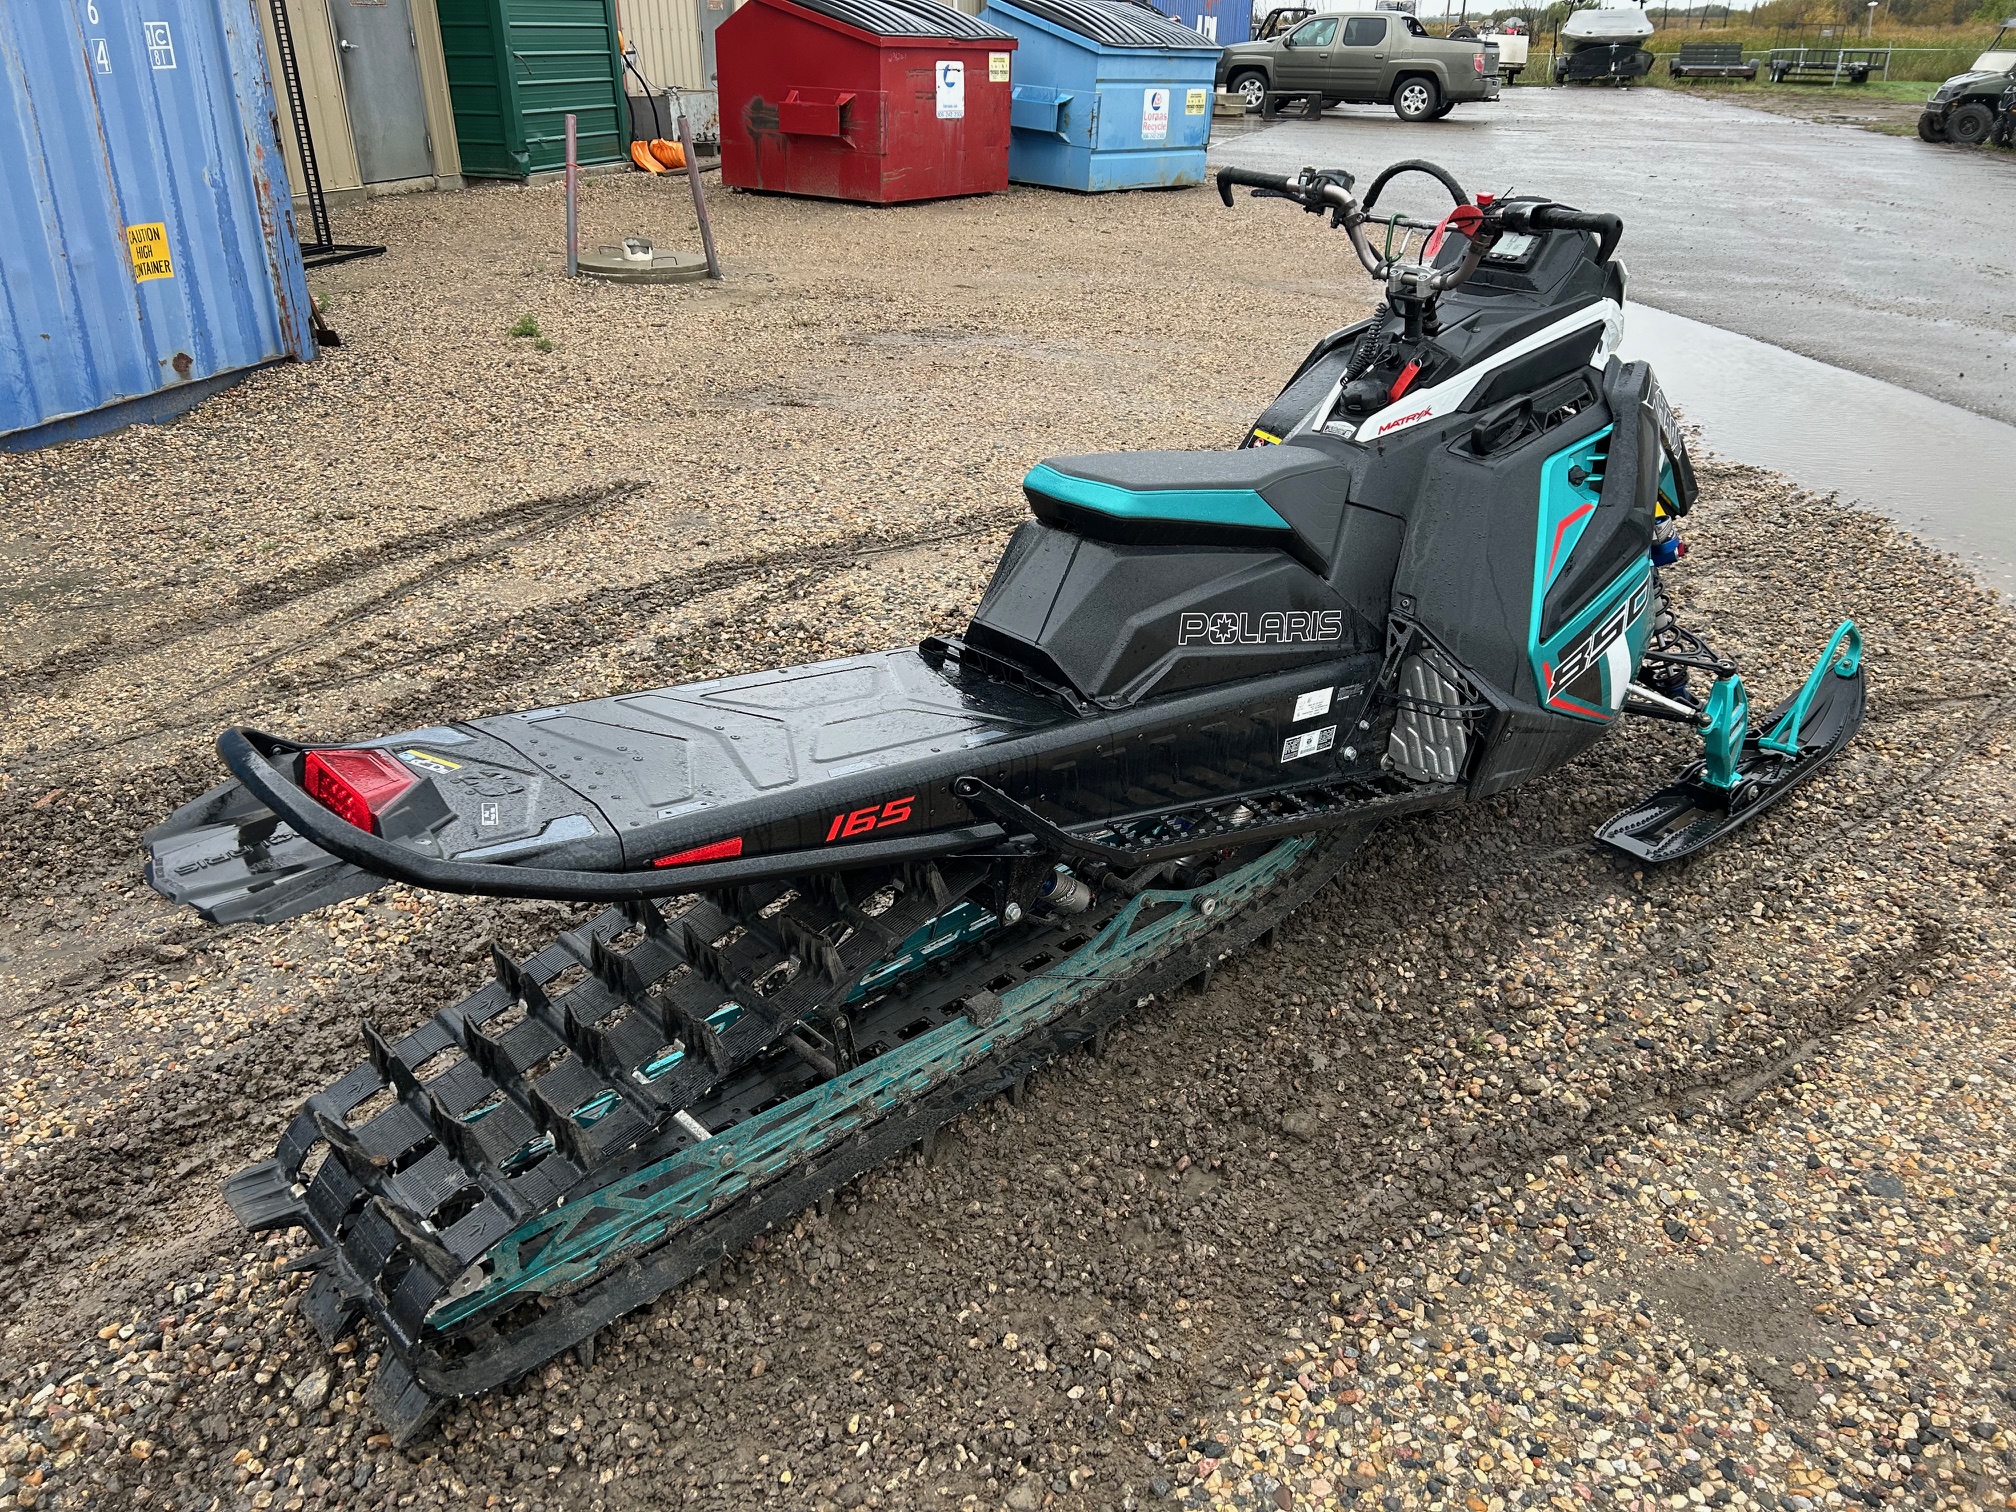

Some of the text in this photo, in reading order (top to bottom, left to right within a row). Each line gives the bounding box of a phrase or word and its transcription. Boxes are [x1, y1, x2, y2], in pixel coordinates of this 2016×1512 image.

[153, 49, 167, 66] 81
[1143, 111, 1168, 121] Loraas
[1142, 121, 1167, 133] Recycle
[128, 227, 161, 245] CAUTION
[136, 244, 154, 260] HIGH
[134, 259, 172, 279] CONTAINER
[1377, 405, 1434, 436] MATRYX
[1177, 609, 1344, 646] POLARIS
[1545, 572, 1652, 705] 850
[825, 794, 917, 843] 165
